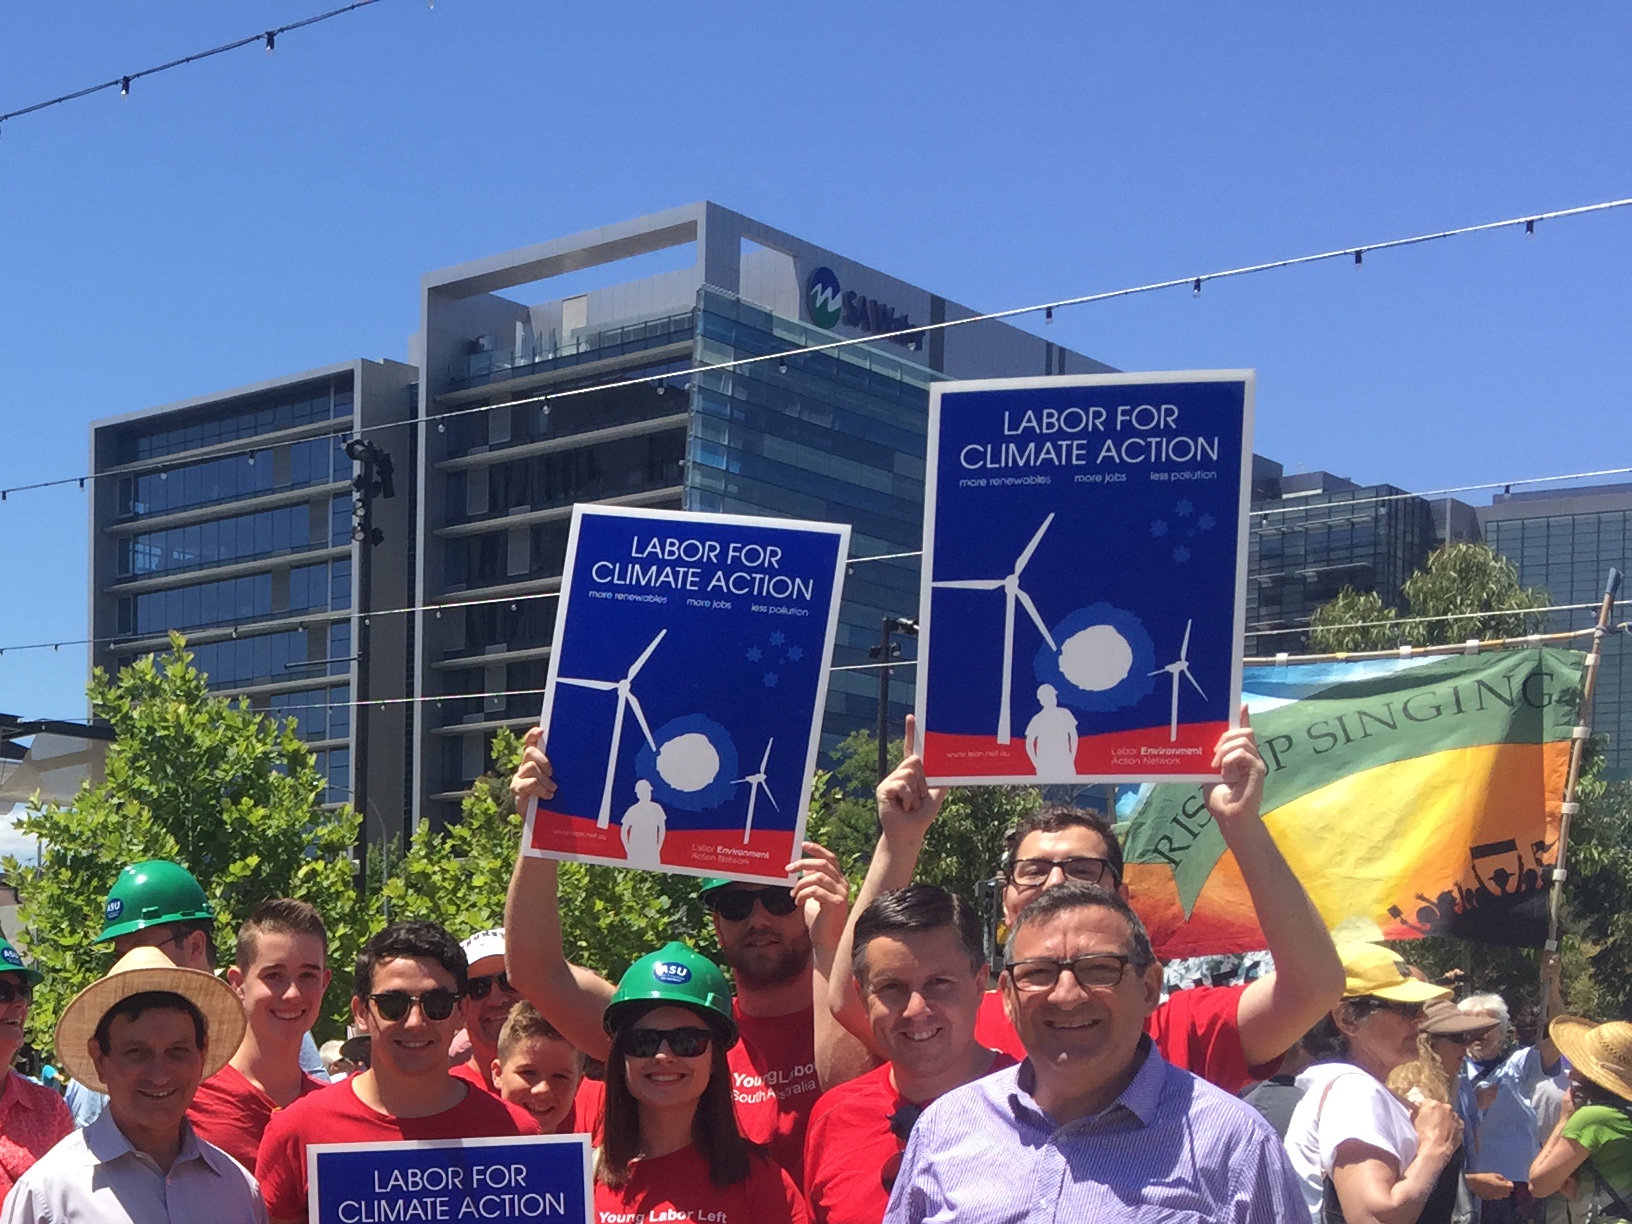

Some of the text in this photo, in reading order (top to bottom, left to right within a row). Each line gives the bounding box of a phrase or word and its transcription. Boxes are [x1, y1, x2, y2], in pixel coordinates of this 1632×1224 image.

[1003, 404, 1179, 435] LABOR FOR
[959, 435, 1219, 469] CLIMATE ACTION
[958, 469, 1217, 487] more renewables more jobs less pollution
[630, 534, 782, 569] LABOR FOR
[591, 560, 814, 601] CLIMATE ACTION
[588, 590, 809, 617] more renewables more jobs less pollution
[1139, 746, 1203, 756] Environment
[1152, 785, 1214, 871] RIS
[1306, 671, 1555, 755] SINGING
[373, 1163, 527, 1193] LABOR FOR
[337, 1192, 565, 1224] CLIMATE ACTION
[599, 1208, 728, 1224] Young Labor Left
